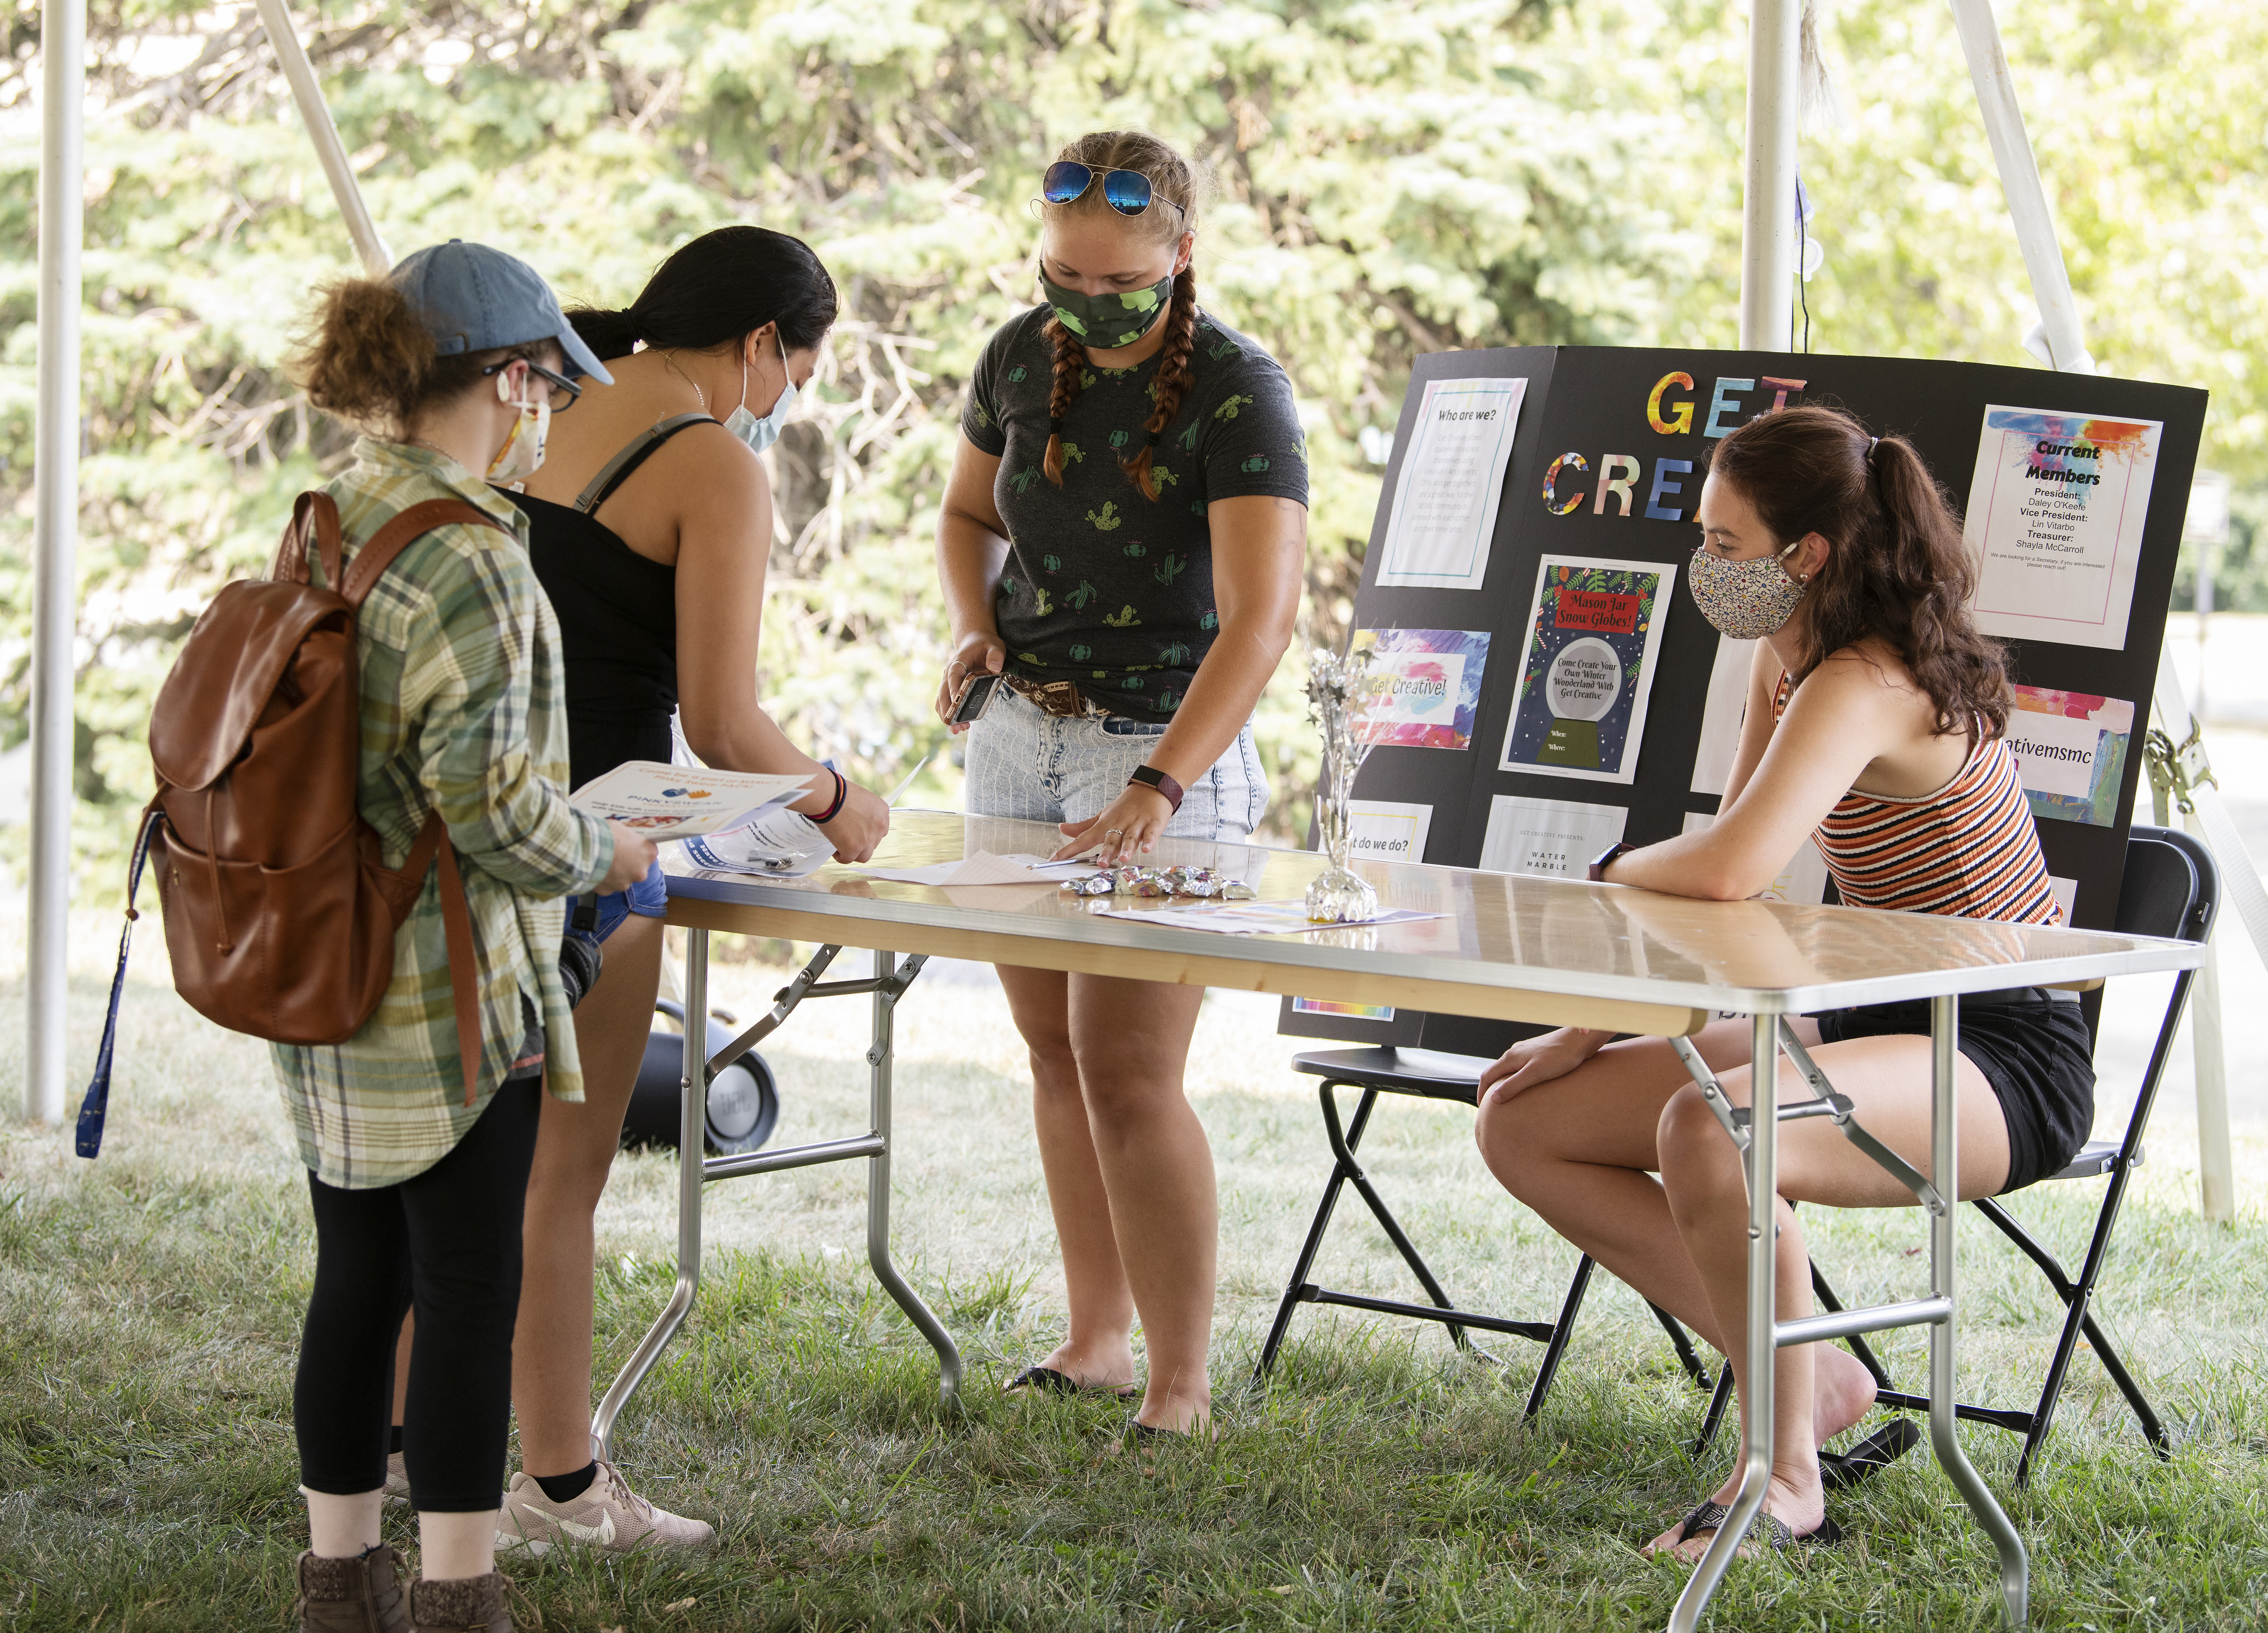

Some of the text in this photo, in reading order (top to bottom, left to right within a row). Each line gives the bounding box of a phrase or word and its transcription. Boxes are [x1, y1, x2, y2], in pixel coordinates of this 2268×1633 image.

[1647, 371, 1807, 438] GET
[1439, 410, 1496, 421] Who are we?
[2036, 440, 2100, 459] Current
[2025, 465, 2100, 486] Members
[1443, 480, 1452, 488] get
[1543, 452, 1700, 523] CRE
[2034, 488, 2081, 500] President:
[1435, 503, 1462, 512] community
[2029, 498, 2086, 511] Daley O'Keefe
[2020, 507, 2088, 522] Vice President:
[2032, 520, 2075, 531] Lin Vitarbo
[2027, 530, 2073, 542] Treasurer:
[2016, 539, 2084, 554] Shayla McCarroll
[1569, 592, 1629, 612] Mason Jar
[1559, 610, 1632, 628] Snow Globes!
[1558, 658, 1617, 672] Come Create Your
[1564, 668, 1606, 680] Own Winter
[1371, 677, 1446, 696] Get Creative!
[1554, 677, 1614, 691] Wonderland With
[1561, 688, 1602, 699] Get Creative
[1551, 730, 1567, 738] When:
[654, 775, 683, 784] Pinky
[1359, 837, 1371, 849] do
[1373, 840, 1387, 850] we
[1389, 839, 1408, 852] do?
[699, 844, 718, 863] Have
[1532, 852, 1566, 861] WATER
[1527, 861, 1567, 870] MARBLE
